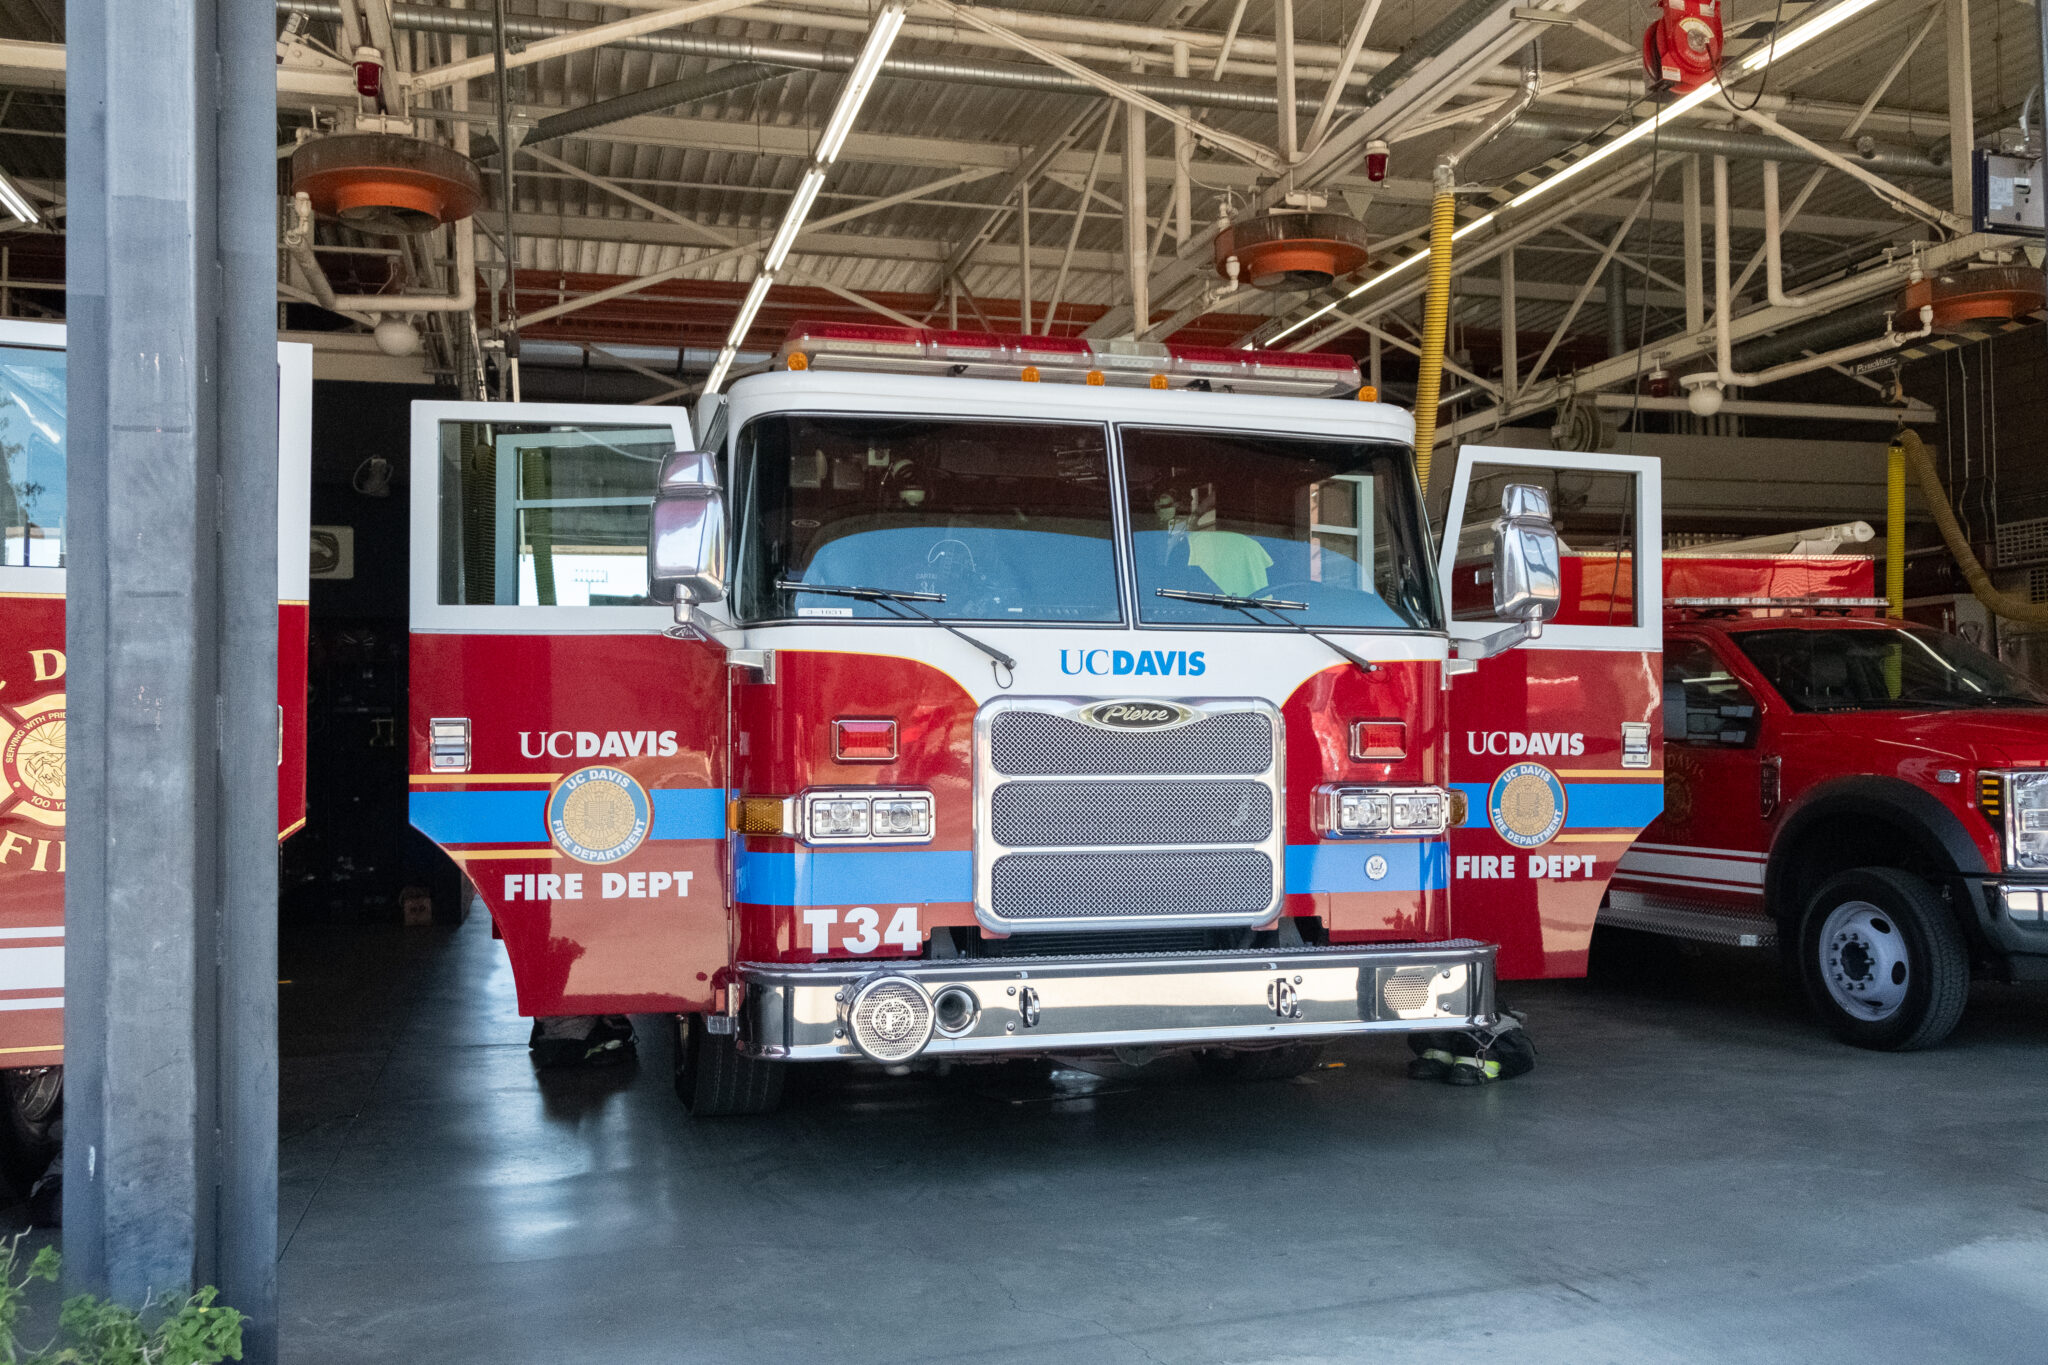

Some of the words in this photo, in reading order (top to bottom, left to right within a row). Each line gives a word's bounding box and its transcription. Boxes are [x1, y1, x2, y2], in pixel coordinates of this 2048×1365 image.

[1102, 705, 1169, 723] Pierce
[6, 729, 25, 764] SERVING
[23, 714, 46, 731] WITH
[565, 773, 586, 790] UC
[589, 769, 631, 788] DAVIS
[1503, 768, 1518, 783] UC
[1520, 765, 1551, 782] DAVIS
[30, 794, 51, 809] 100
[552, 819, 573, 848] FIRE
[571, 818, 646, 861] DEPARTMENT
[1492, 808, 1507, 833] FIRE
[1507, 808, 1562, 845] DEPARTMENT
[1456, 855, 1515, 879] FIRE
[1528, 855, 1597, 878] DEPT
[504, 872, 583, 901] FIRE
[602, 871, 694, 900] DEPT
[803, 906, 923, 954] T34
